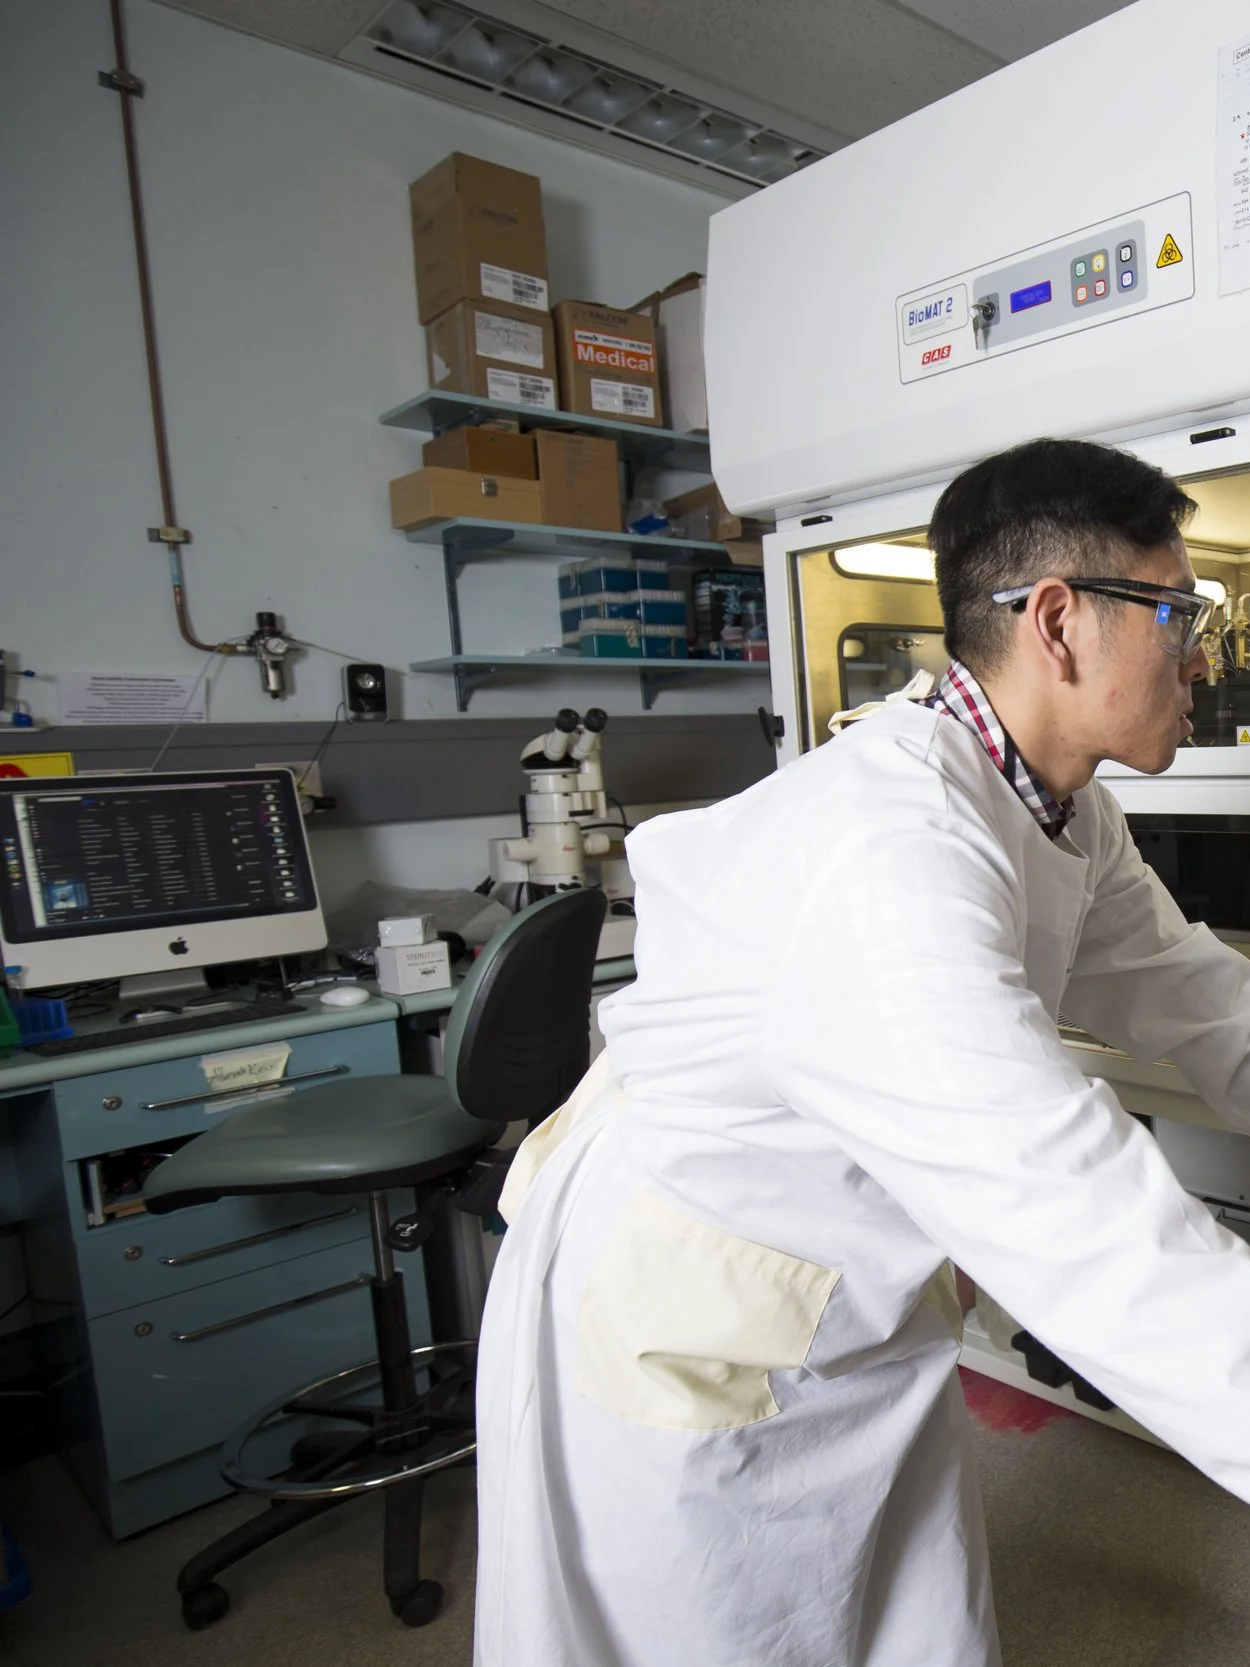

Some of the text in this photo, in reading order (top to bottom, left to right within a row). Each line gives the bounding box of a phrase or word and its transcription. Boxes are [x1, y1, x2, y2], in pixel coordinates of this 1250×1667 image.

[908, 300, 943, 326] BioMAT
[946, 296, 953, 313] 2
[576, 344, 655, 372] Medical
